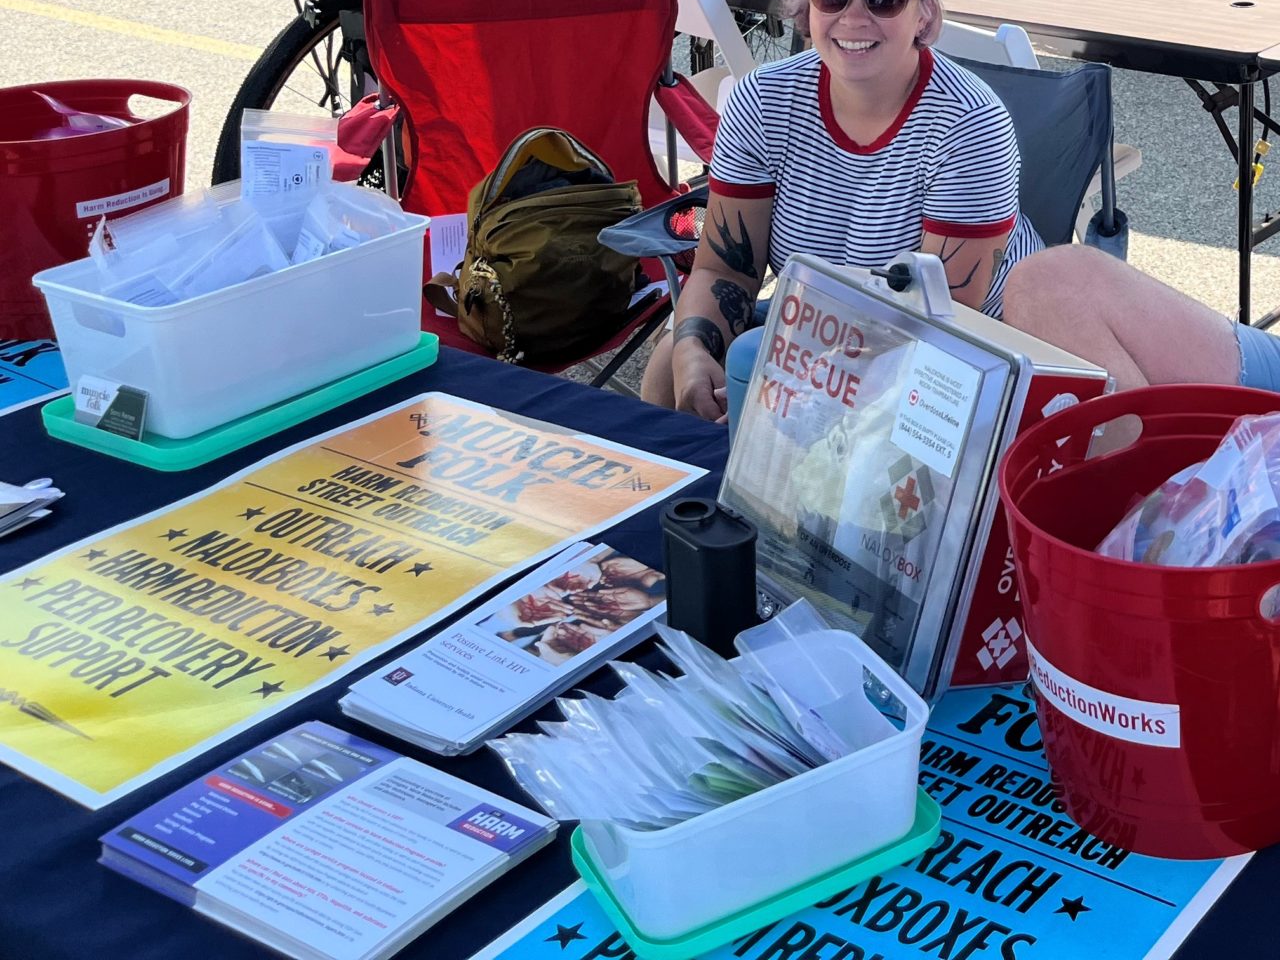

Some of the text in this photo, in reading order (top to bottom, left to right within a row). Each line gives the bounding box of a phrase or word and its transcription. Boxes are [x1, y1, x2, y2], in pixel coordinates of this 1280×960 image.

[83, 203, 104, 212] Harm
[106, 193, 141, 208] Reduction
[781, 294, 865, 358] OPIOID
[81, 386, 110, 401] muncie
[757, 375, 798, 418] KIT
[768, 334, 861, 409] RESCUE
[396, 444, 554, 503] FOLK
[418, 414, 633, 490] MUNCIE
[934, 443, 946, 456] EXT.
[298, 478, 493, 547] STREET OUTREACH
[330, 465, 515, 531] HARM REDUCTION
[170, 530, 383, 612] NALOXBOXES
[254, 507, 424, 574] OUTREACH
[861, 533, 923, 584] NALOXBOX
[24, 578, 276, 690] PEER RECOVERY
[87, 549, 343, 658] HARM REDUCTION
[1, 621, 173, 698] SUPPORT
[440, 639, 475, 661] services
[451, 632, 487, 654] Positive
[485, 649, 509, 666] Link
[506, 661, 531, 675] HIV
[403, 681, 476, 720] Indiana University Health
[956, 693, 1045, 752] FO
[919, 740, 982, 778] ARM
[467, 811, 526, 840] HARM
[967, 794, 1133, 871] OUTREACH
[901, 830, 1063, 915] REACH
